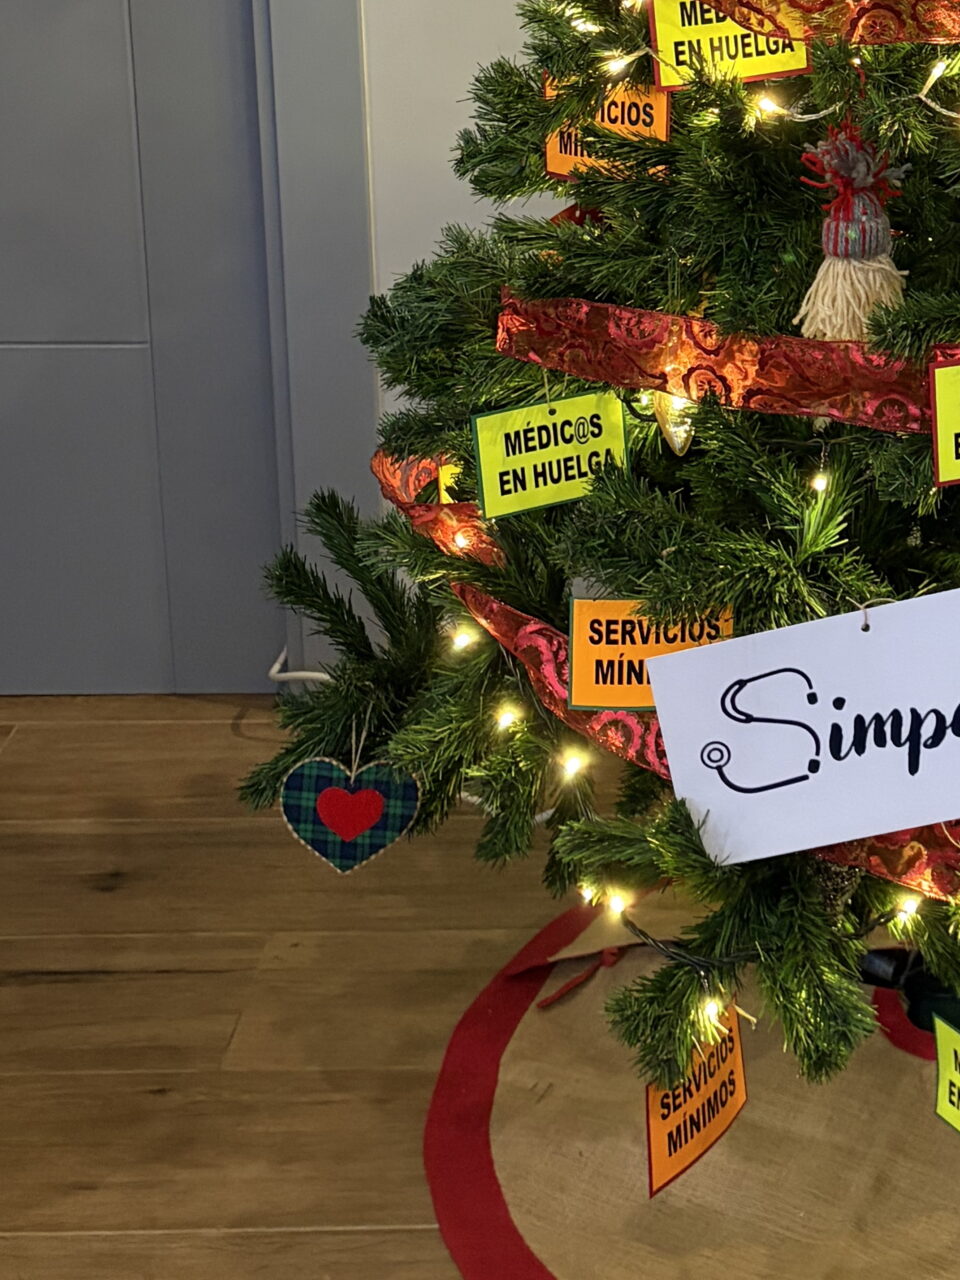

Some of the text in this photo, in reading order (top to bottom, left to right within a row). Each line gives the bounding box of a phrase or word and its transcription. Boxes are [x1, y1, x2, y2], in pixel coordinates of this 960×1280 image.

[709, 32, 796, 62] HUELGA
[504, 413, 604, 458] MÉDIC@S
[498, 466, 528, 497] EN
[660, 1025, 735, 1121] SERVICIOS
[667, 1069, 736, 1158] MÍNIMOS
